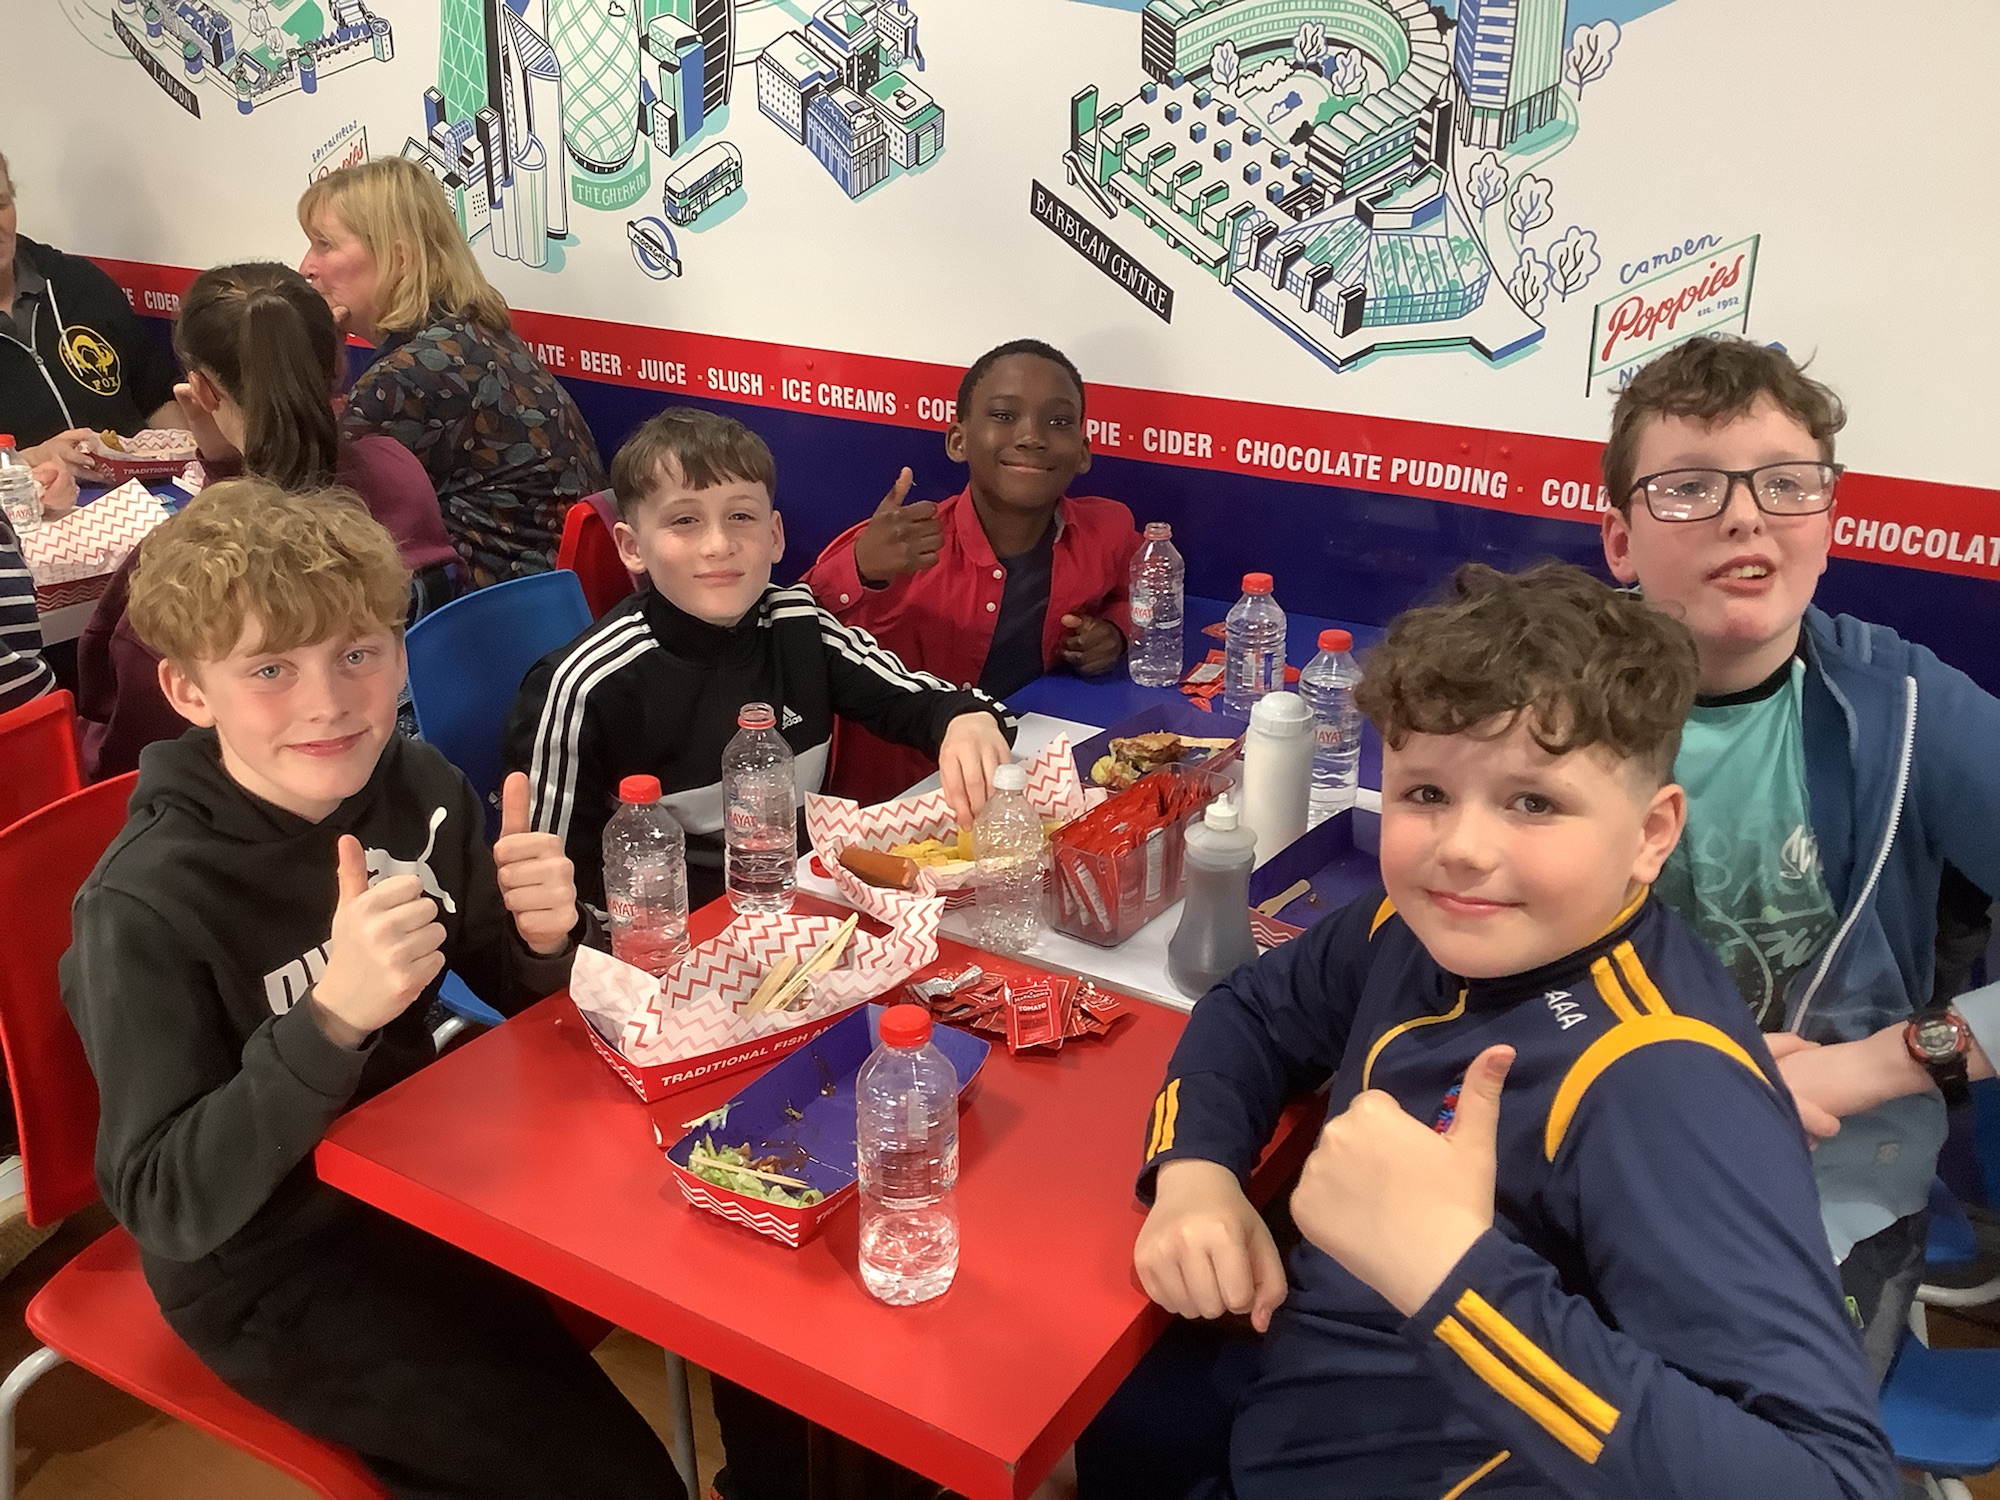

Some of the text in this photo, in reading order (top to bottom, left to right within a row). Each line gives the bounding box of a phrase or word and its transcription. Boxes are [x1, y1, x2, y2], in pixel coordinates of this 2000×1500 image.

[153, 62, 193, 110] LONDON
[577, 171, 647, 206] THE GHERKIN
[633, 233, 671, 267] MOORGATE
[1035, 190, 1167, 314] BARBICAN CENTRE
[144, 290, 181, 312] CIDER
[1601, 254, 1745, 361] Poppies
[1717, 297, 1740, 311] 1952
[580, 350, 623, 377] BEER
[638, 358, 687, 386] JUICE
[707, 366, 763, 397] SLUSH
[782, 377, 812, 404] ICE
[817, 382, 897, 416] CREAMS
[122, 466, 180, 476] TRADITIONAL
[1086, 418, 1121, 447] PIE
[1142, 426, 1213, 459] CIDER
[1235, 437, 1383, 482] CHOCOLATE
[1390, 457, 1509, 499] PUDDING
[1018, 1002, 1047, 1012] TOMATO
[661, 1046, 769, 1086] TRADITIONAL
[773, 1032, 809, 1051] FISH
